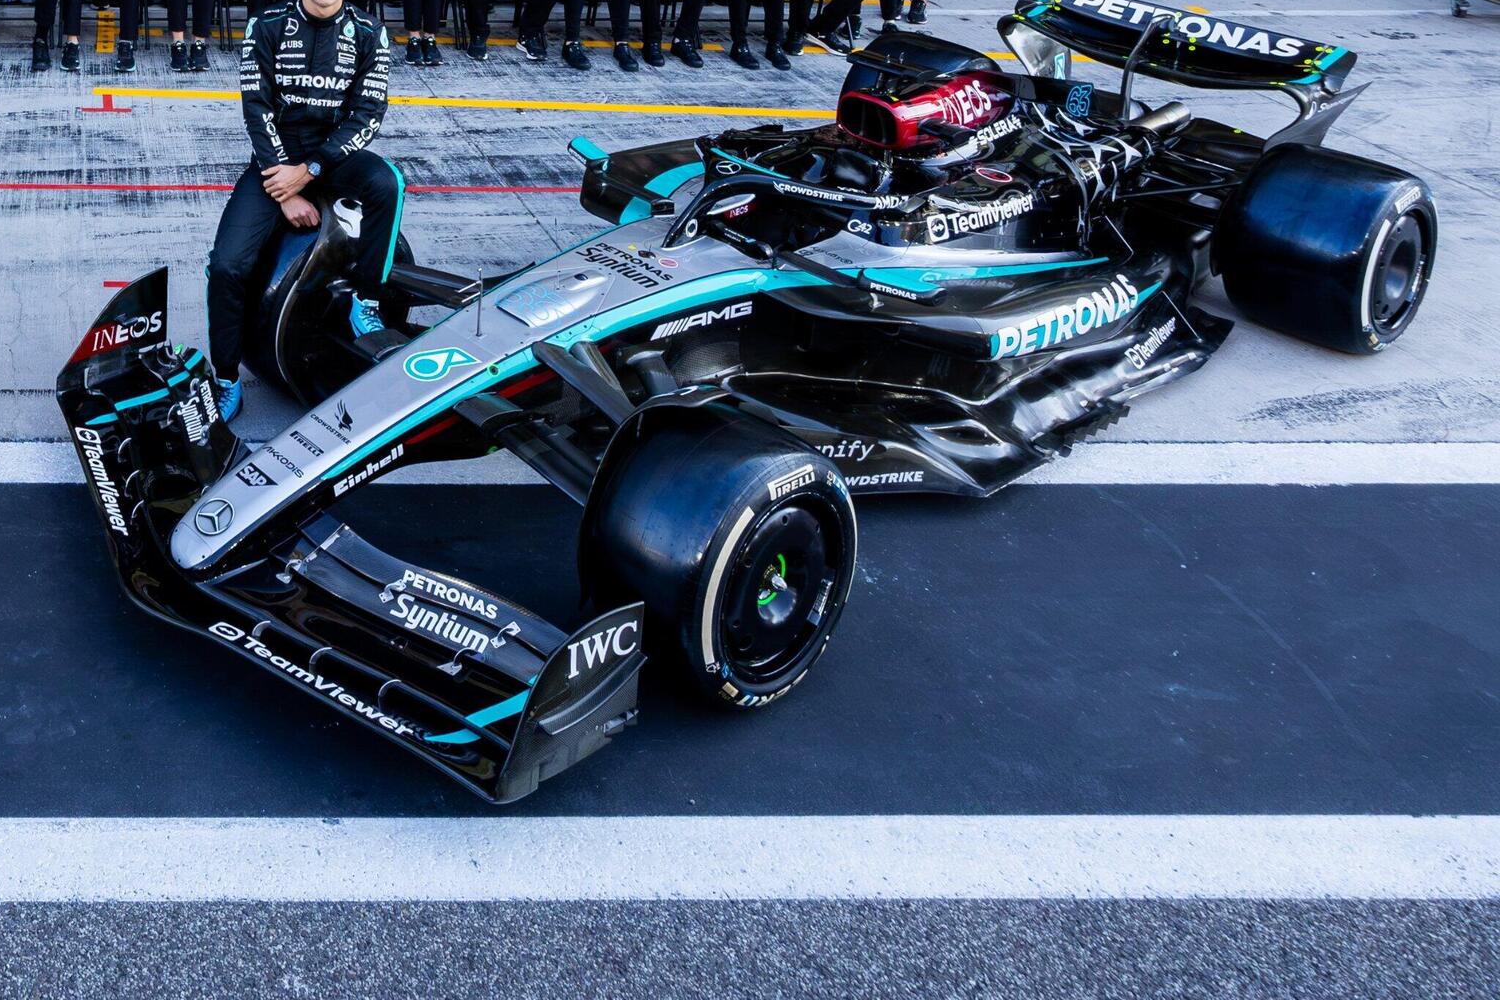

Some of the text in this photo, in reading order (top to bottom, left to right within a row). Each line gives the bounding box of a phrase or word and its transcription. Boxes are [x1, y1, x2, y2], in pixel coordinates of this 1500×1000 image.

[287, 40, 304, 49] UBS
[943, 79, 992, 130] INEOS
[340, 118, 380, 156] INEOS
[975, 117, 1015, 146] SOLERA
[778, 183, 844, 202] CROWDSTRIKE
[847, 219, 873, 235] G42
[947, 194, 1036, 237] TeamViewer
[575, 245, 660, 290] Syntium
[595, 242, 675, 283] PETRONAS
[869, 281, 918, 301] PETRONAS
[91, 310, 163, 352] INEOS
[685, 301, 753, 332] AMG
[992, 273, 1140, 362] PETRONAS
[1134, 317, 1177, 365] TeamViewer
[199, 379, 220, 425] PETRONAS
[289, 430, 325, 458] PIRELLI
[309, 412, 353, 445] CROWDSTRIKE
[237, 463, 268, 487] SAP
[262, 443, 306, 479] AKKODIS
[333, 443, 406, 499] Einhell
[845, 471, 924, 486] WDSTRIKE
[85, 440, 130, 538] TeamViewer
[767, 463, 816, 501] PIRELLI
[401, 569, 499, 620] PETRONAS
[389, 592, 490, 655] Syntium
[566, 620, 640, 681] IWC
[243, 635, 417, 738] TeamViewer
